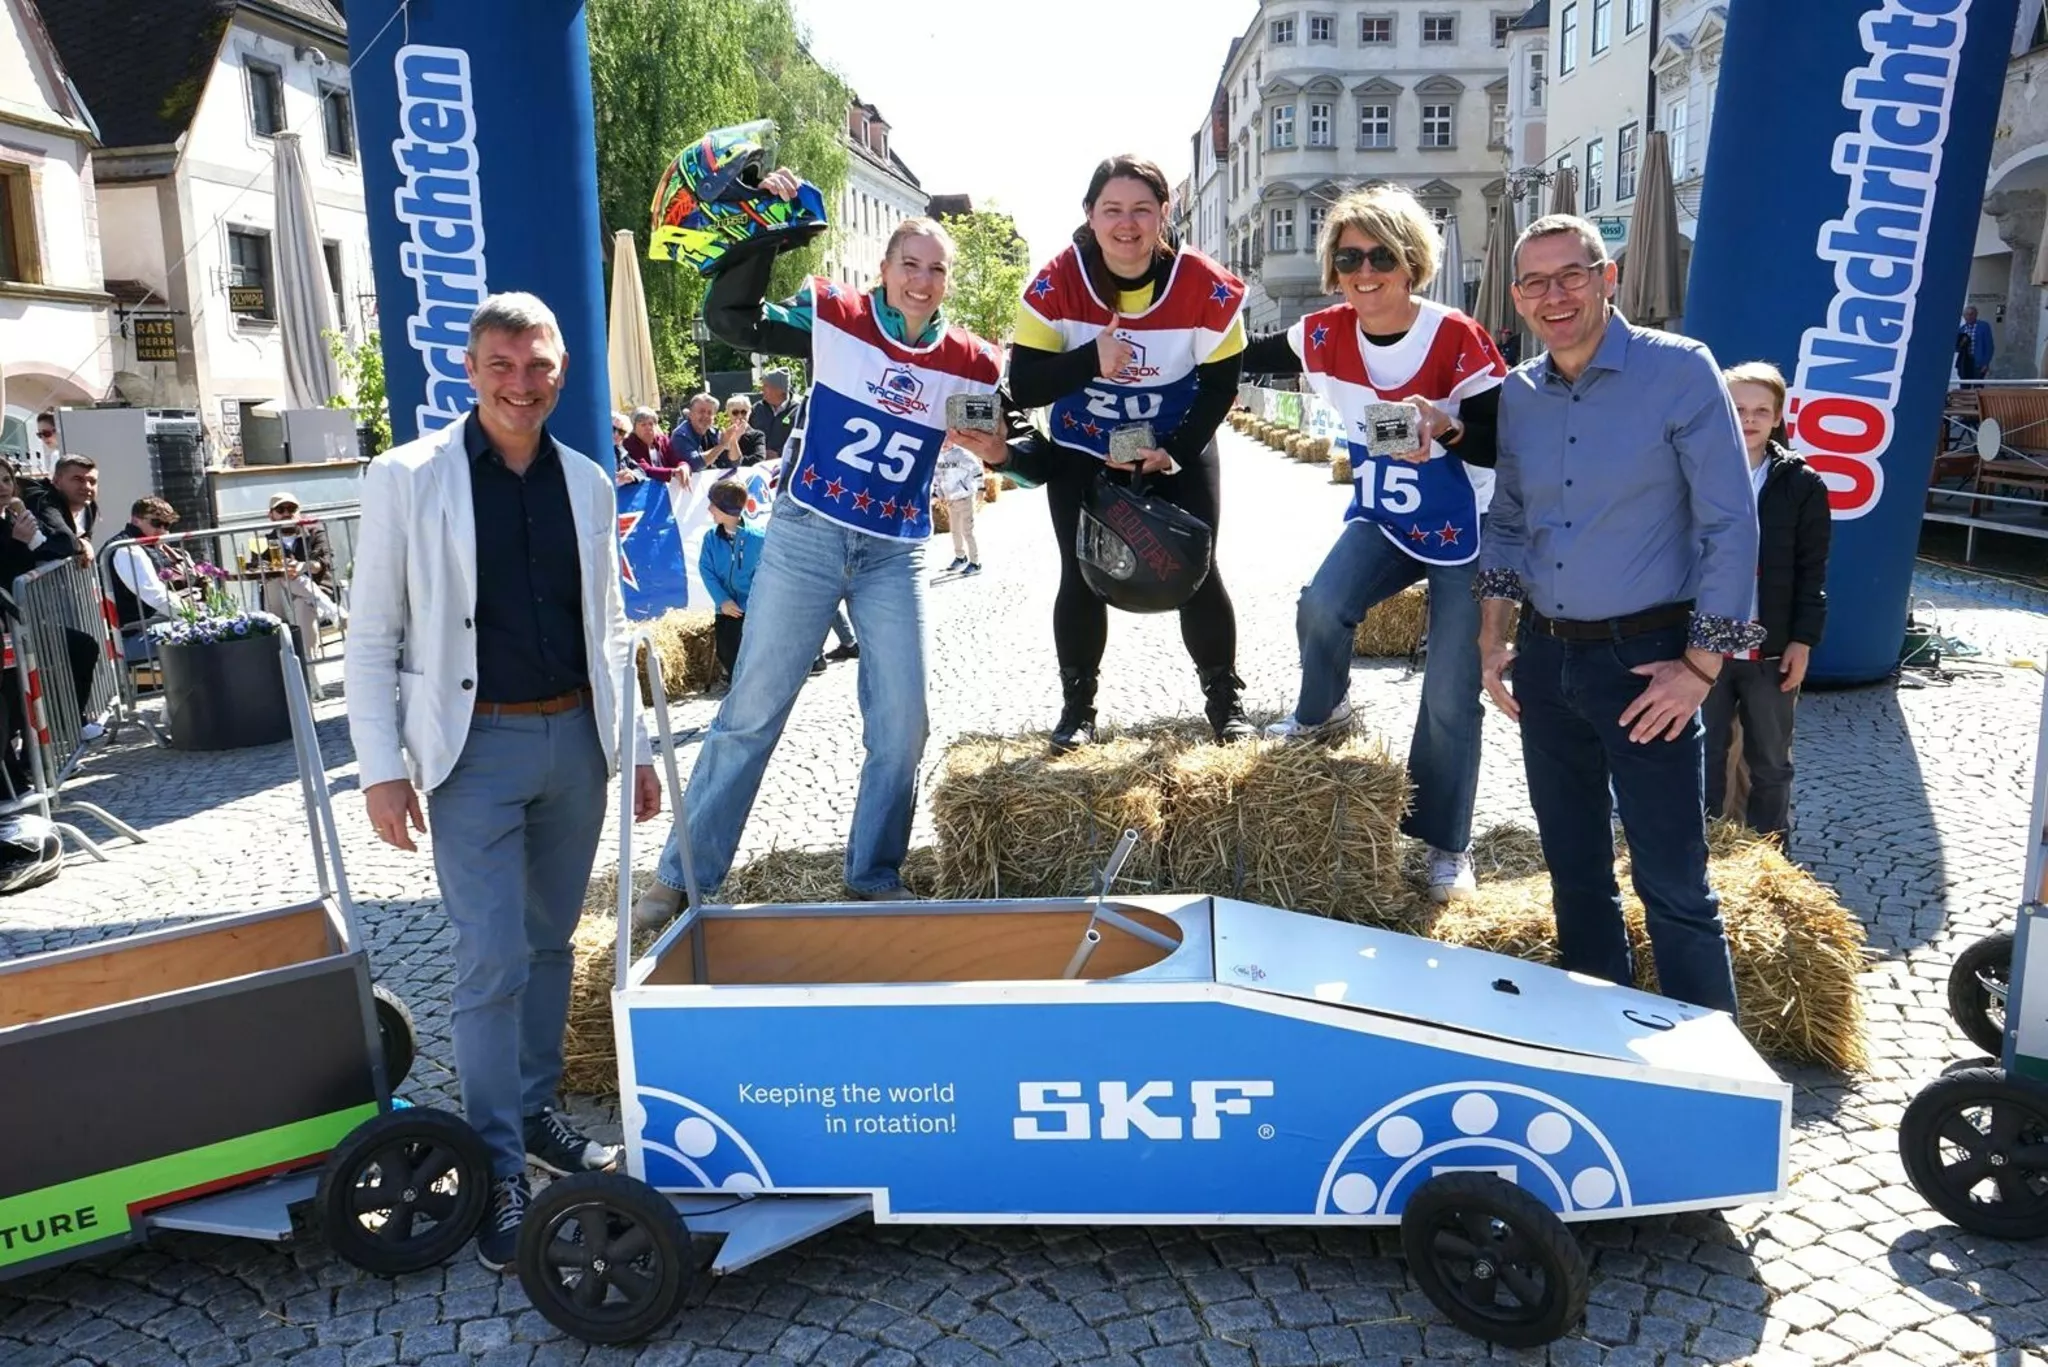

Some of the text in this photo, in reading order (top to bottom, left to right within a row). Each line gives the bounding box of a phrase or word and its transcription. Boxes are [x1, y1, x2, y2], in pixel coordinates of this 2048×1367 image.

[231, 293, 265, 305] OLYMPIA
[136, 322, 174, 335] RATS
[138, 336, 175, 347] HERRN
[138, 348, 176, 359] KELLER
[866, 381, 930, 413] RACEBOX
[1084, 387, 1163, 420] 20
[835, 417, 924, 483] 25
[1352, 460, 1422, 514] 15
[738, 1083, 955, 1108] Keeping the world
[825, 1112, 957, 1133] in rotation!
[1013, 1080, 1275, 1140] SKF
[0, 1205, 99, 1250] TURE
